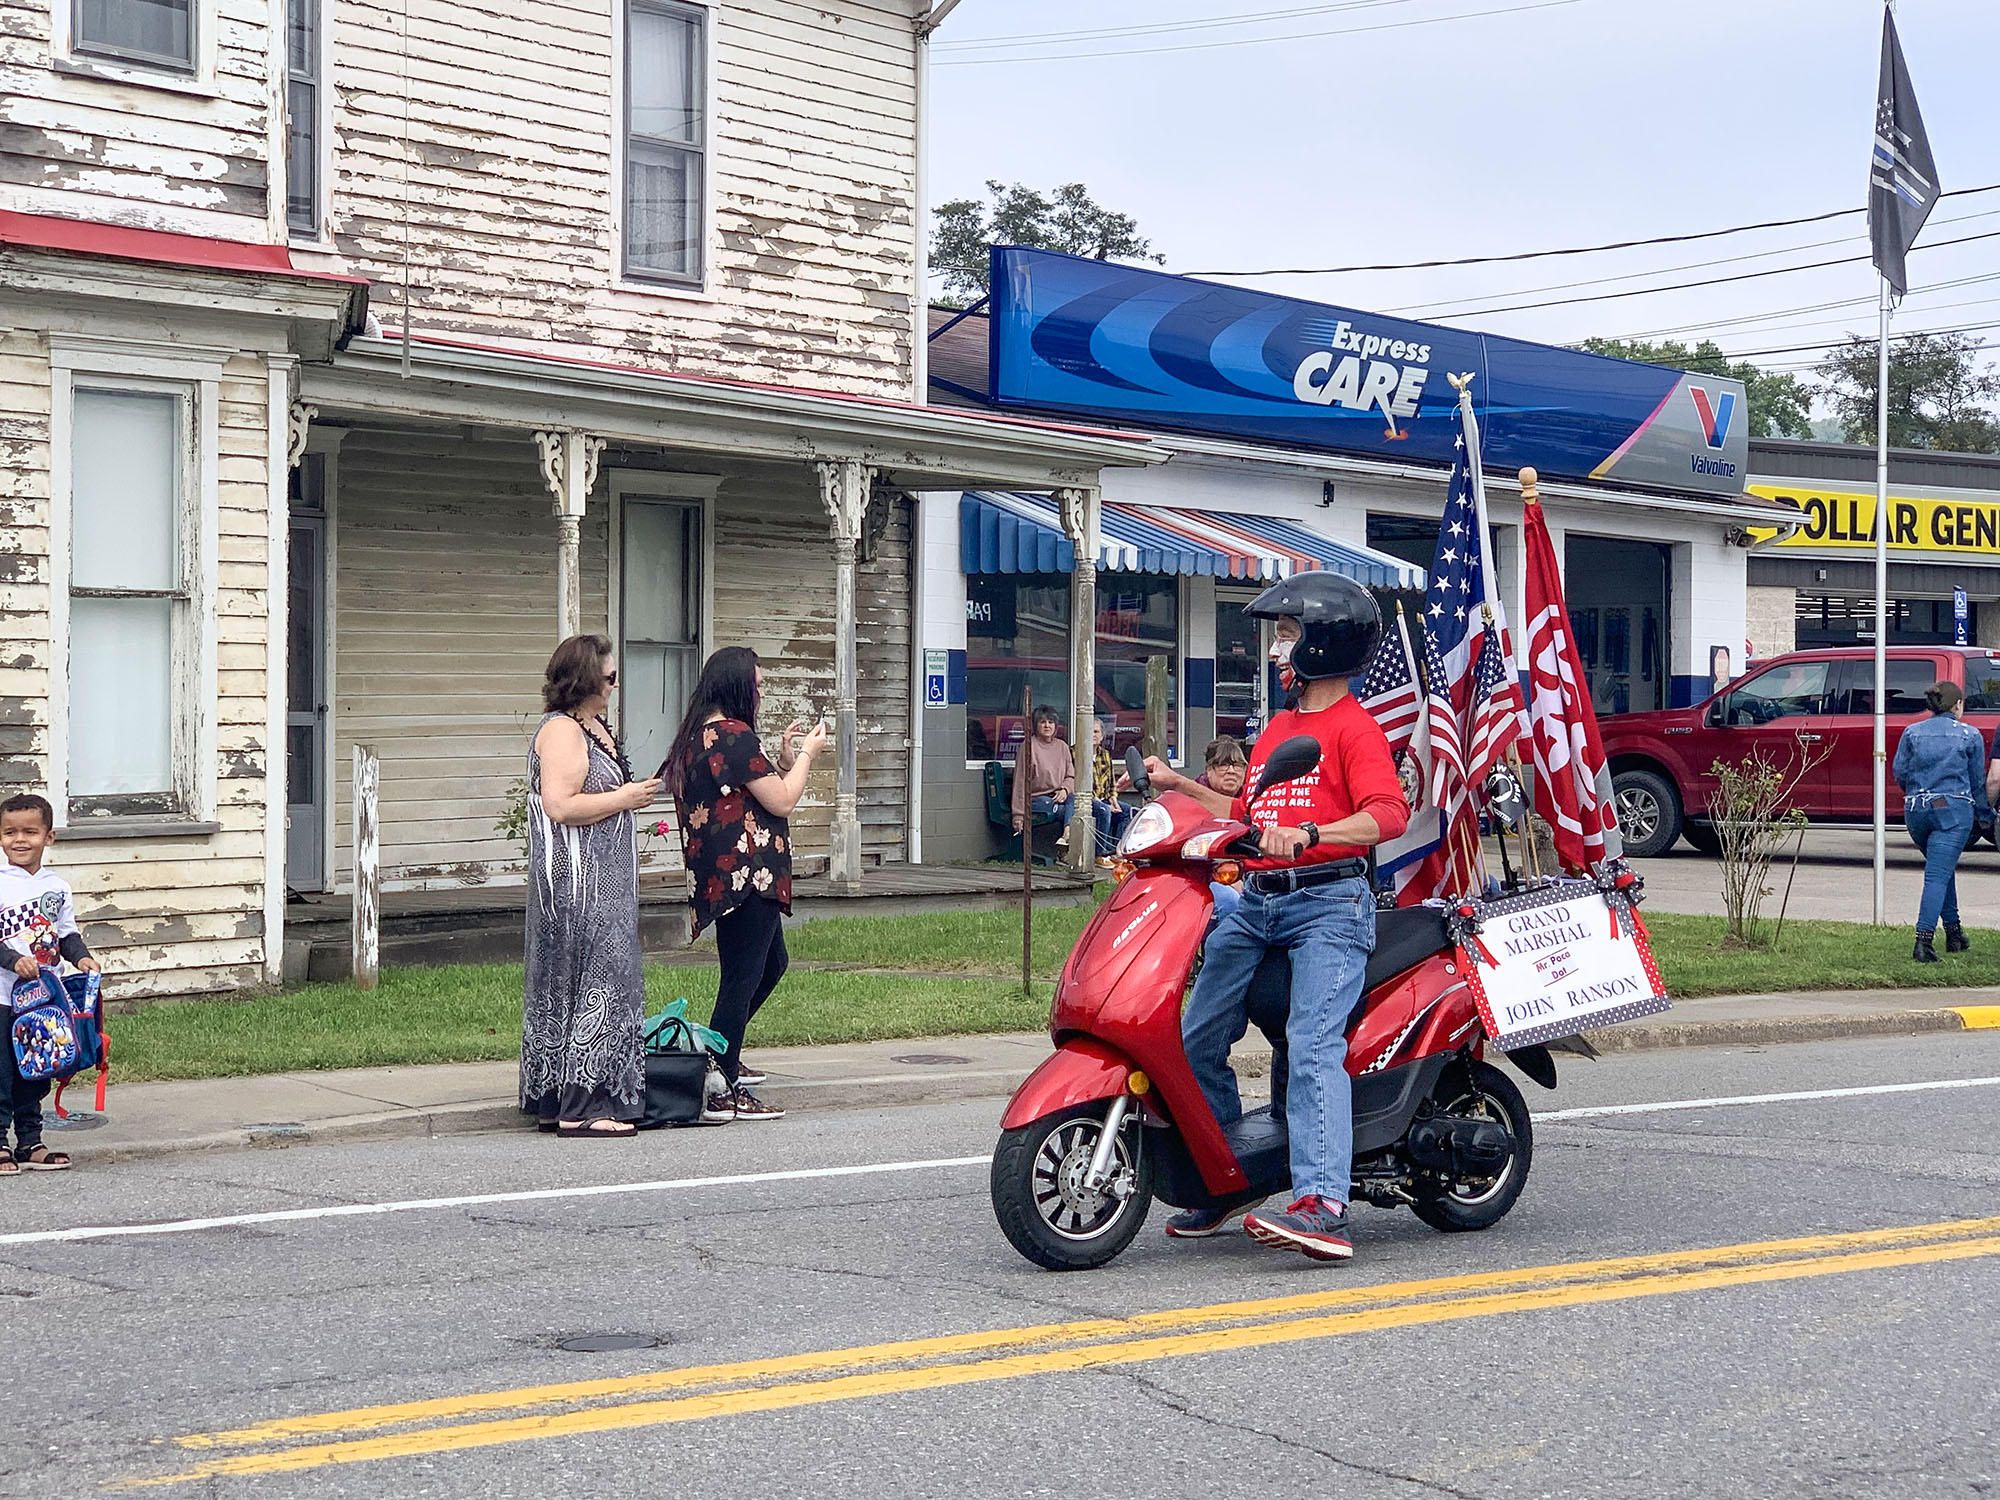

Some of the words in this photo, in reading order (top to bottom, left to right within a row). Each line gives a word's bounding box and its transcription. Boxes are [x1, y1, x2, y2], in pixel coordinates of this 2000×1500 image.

[1331, 320, 1431, 363] Express
[1293, 351, 1428, 436] CARE
[1690, 453, 1736, 478] Valvoline
[1931, 504, 2000, 548] GEN
[1291, 776, 1320, 786] WHAT
[1488, 764, 1508, 774] OW
[1266, 798, 1287, 807] YOU
[1288, 798, 1316, 807] ARE.
[1270, 787, 1287, 797] YOU
[1290, 787, 1311, 796] THE
[1508, 906, 1571, 934] GRAND
[1503, 923, 1592, 957] MARSHAL
[1535, 962, 1551, 973] Mr.
[1551, 950, 1571, 966] Poca
[1506, 996, 1555, 1026] JOHN
[1566, 975, 1640, 1008] RANSON
